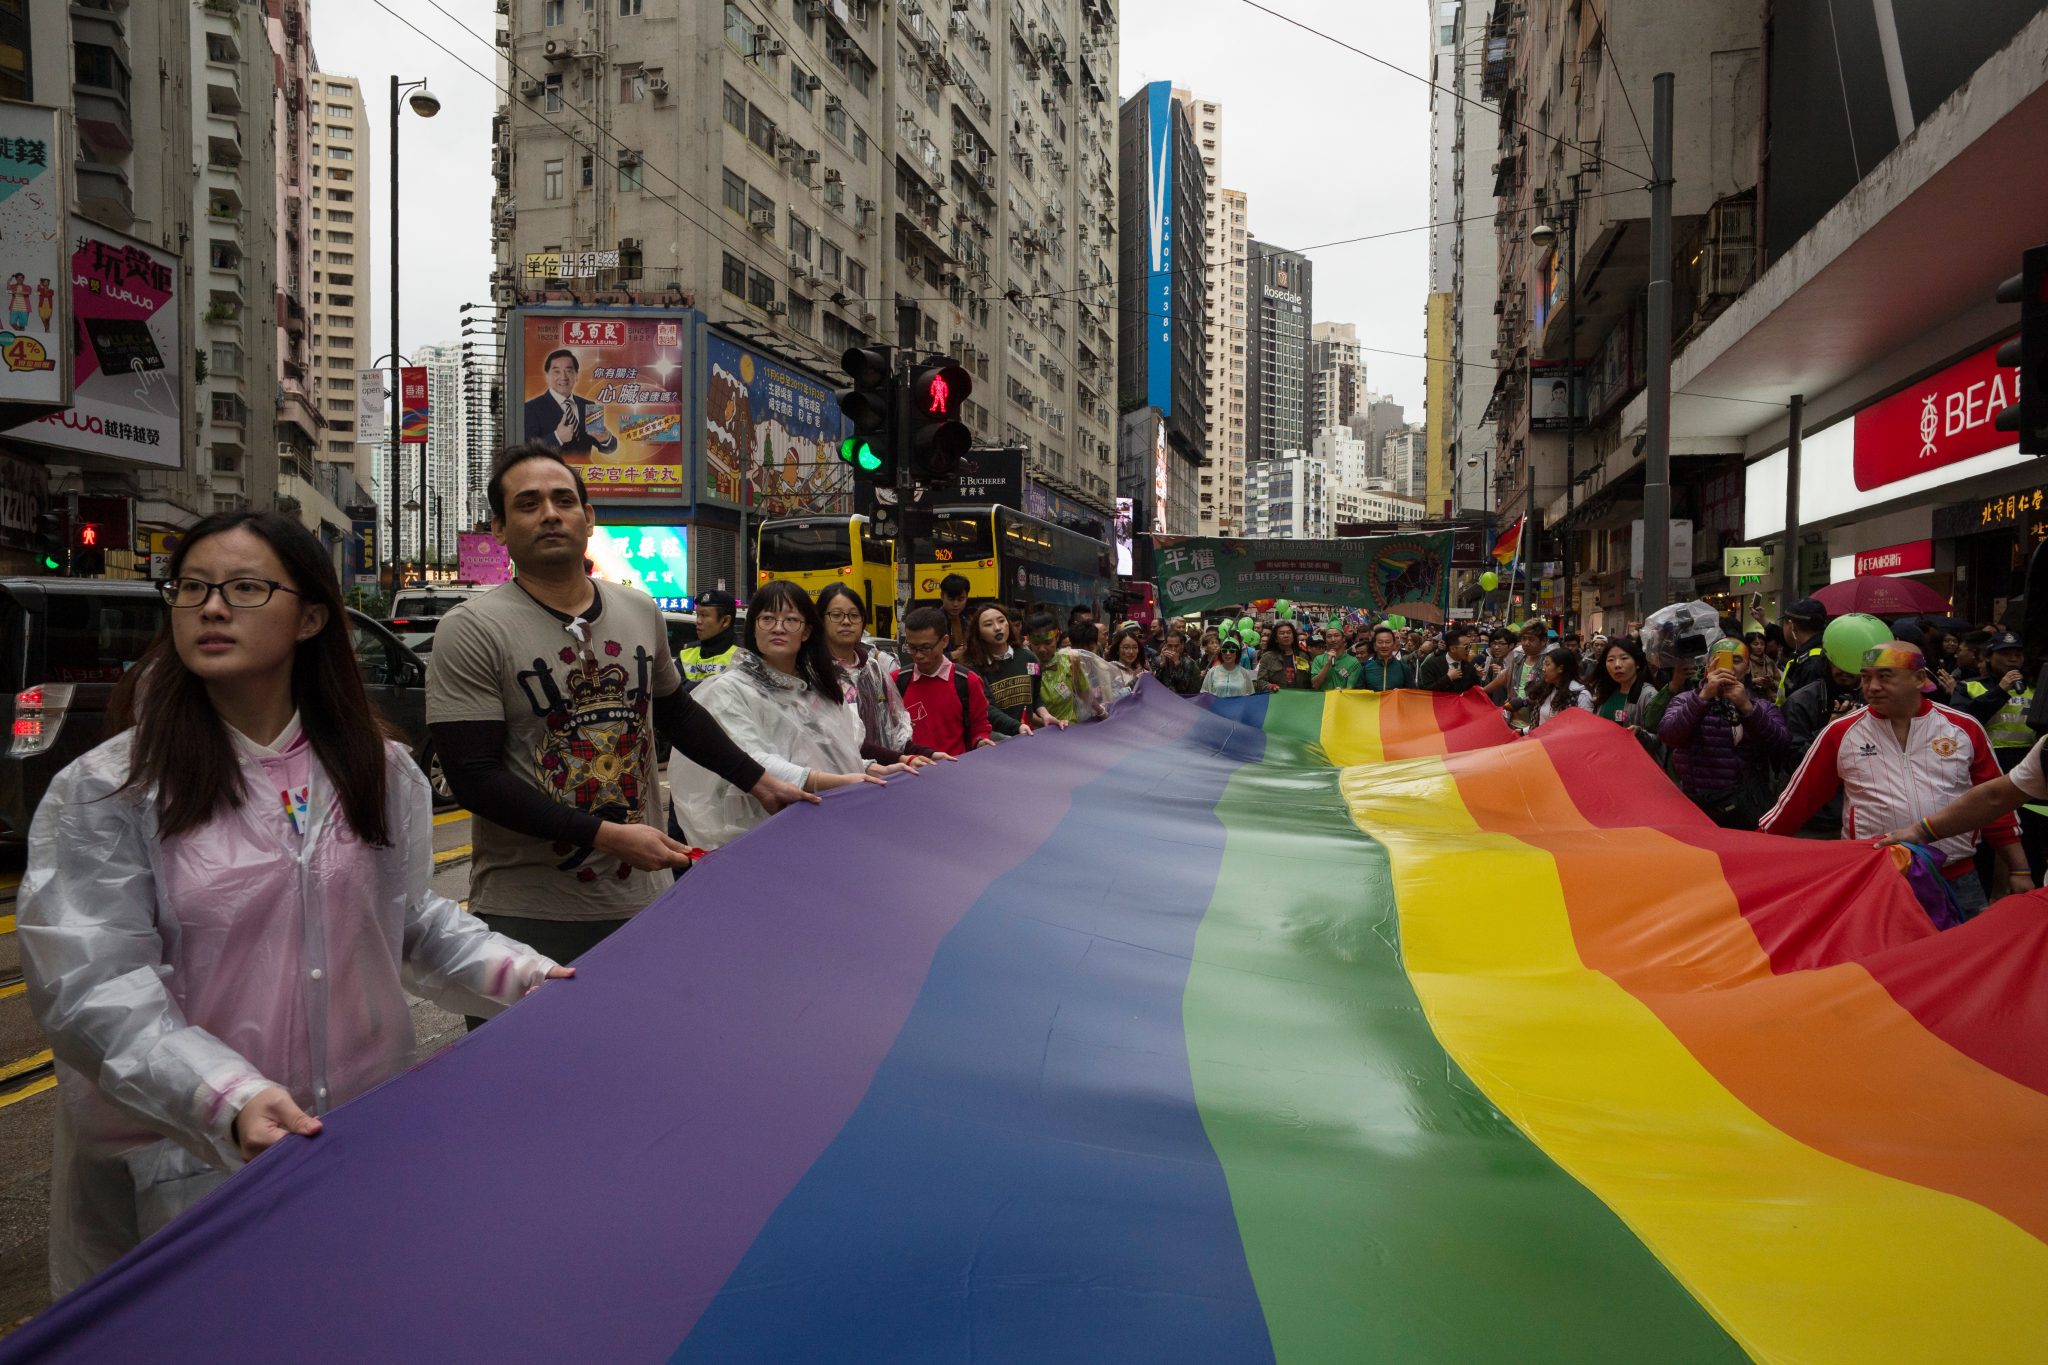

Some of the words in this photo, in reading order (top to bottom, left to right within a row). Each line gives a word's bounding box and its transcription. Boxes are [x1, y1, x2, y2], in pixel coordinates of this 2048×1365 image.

[1264, 284, 1302, 305] Rosedale
[570, 322, 618, 340] 馬百良
[594, 367, 637, 379] 你有關注
[1945, 373, 2007, 437] BEA
[967, 477, 1006, 486] BUCHERER
[1982, 489, 2043, 525] 北京同仁堂
[364, 528, 373, 569] IKEA
[1341, 541, 1365, 551] 2016
[1164, 547, 1215, 571] 平權
[1238, 573, 1253, 581] GET
[1305, 574, 1329, 582] EQUAL
